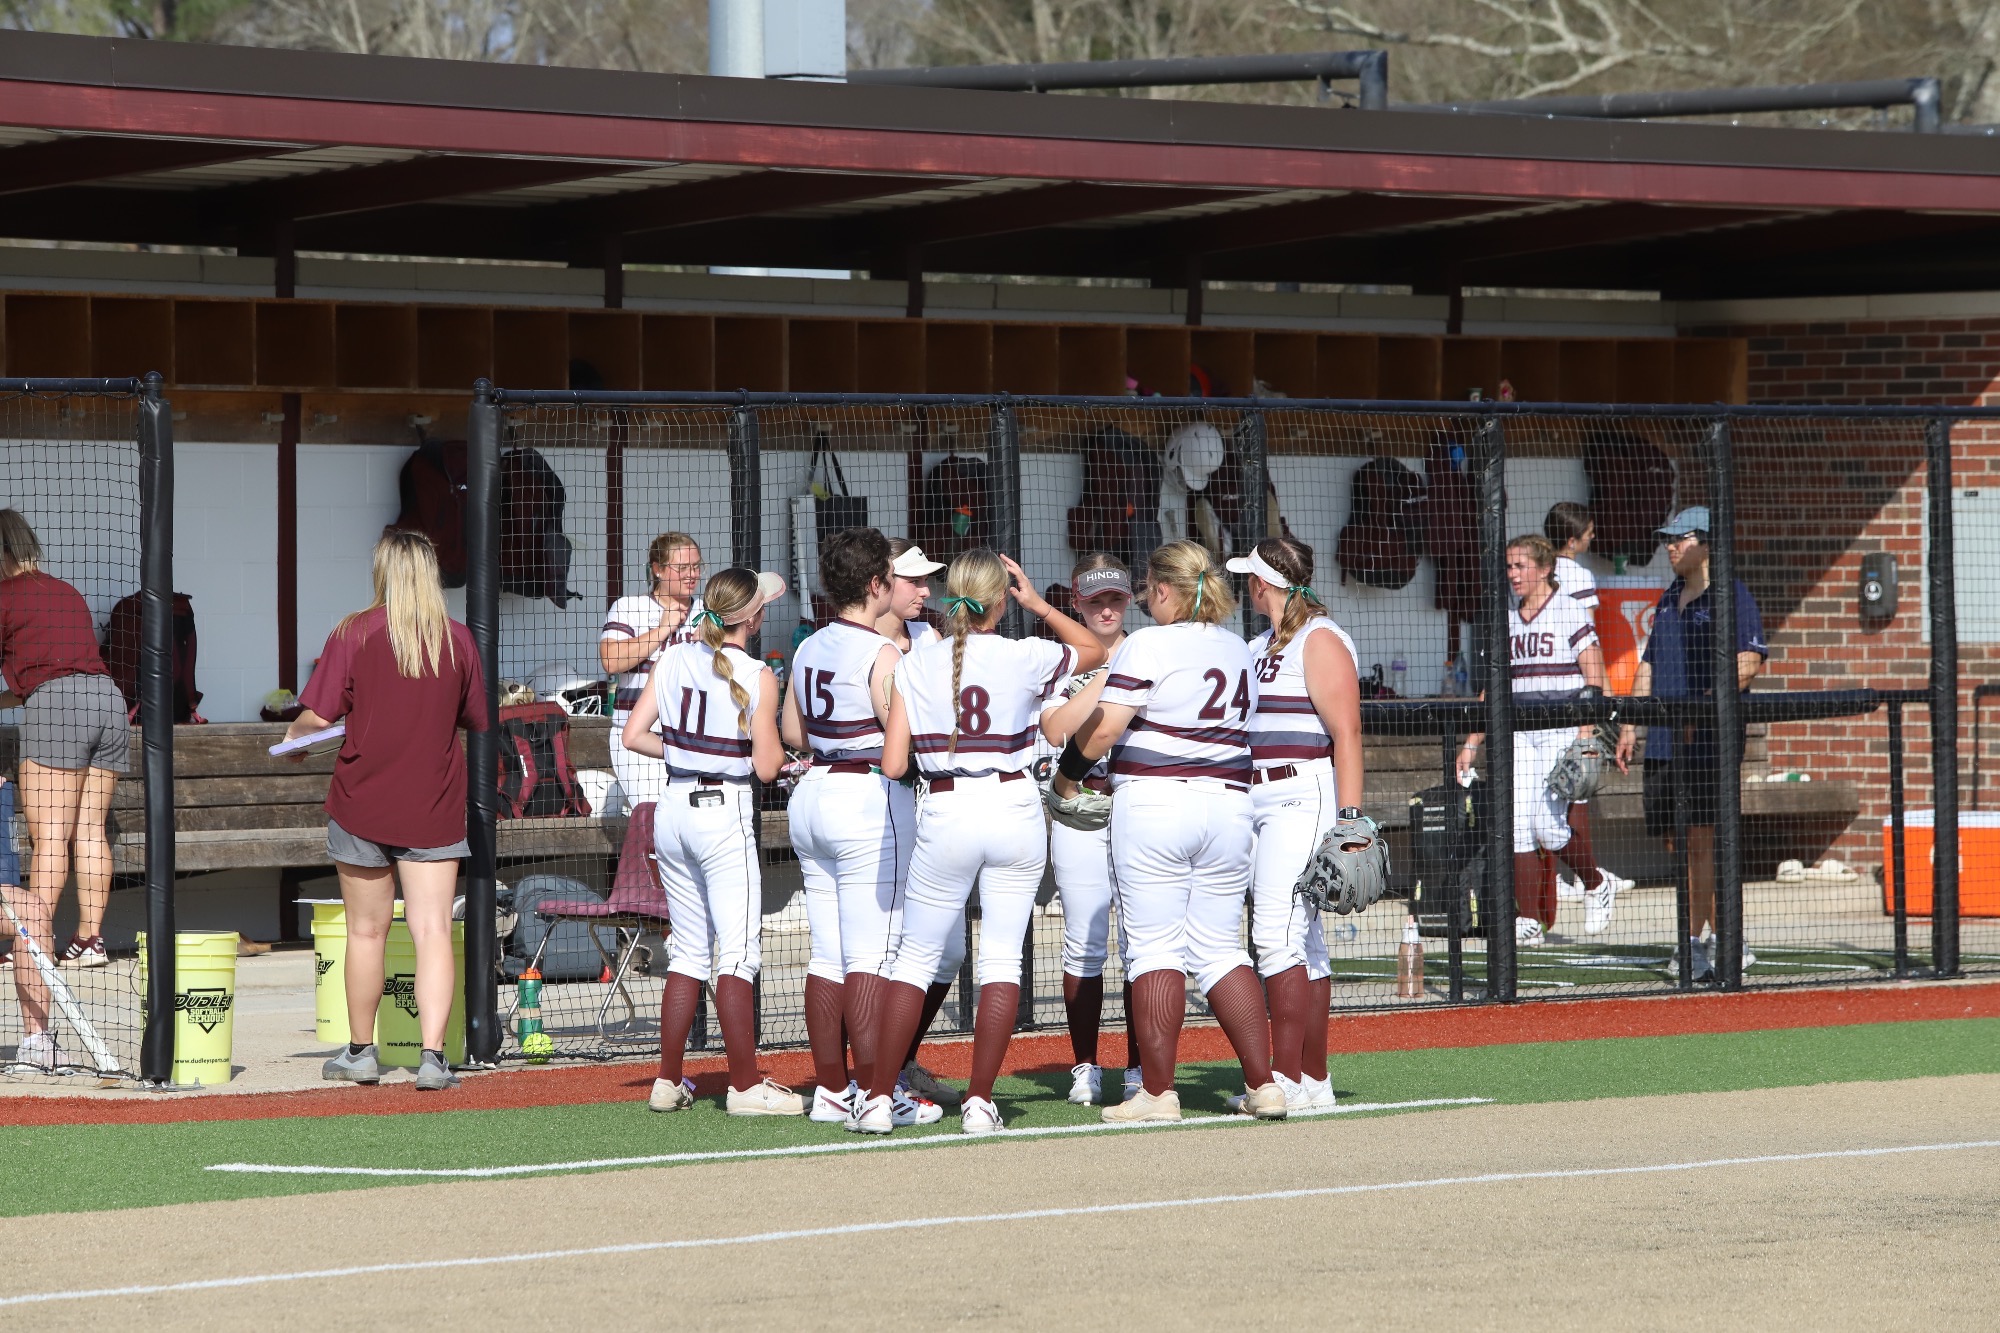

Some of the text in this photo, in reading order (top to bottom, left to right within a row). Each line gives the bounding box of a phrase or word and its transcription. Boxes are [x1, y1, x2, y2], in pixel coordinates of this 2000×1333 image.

[1086, 571, 1120, 582] HINDS
[1509, 632, 1555, 660] INDS
[804, 666, 836, 721] 15
[1197, 667, 1251, 722] 24
[676, 686, 708, 740] 11
[960, 684, 992, 737] 8
[384, 979, 415, 995] DUD
[175, 993, 234, 1011] DUDLEY
[188, 1014, 225, 1023] SERIOUS
